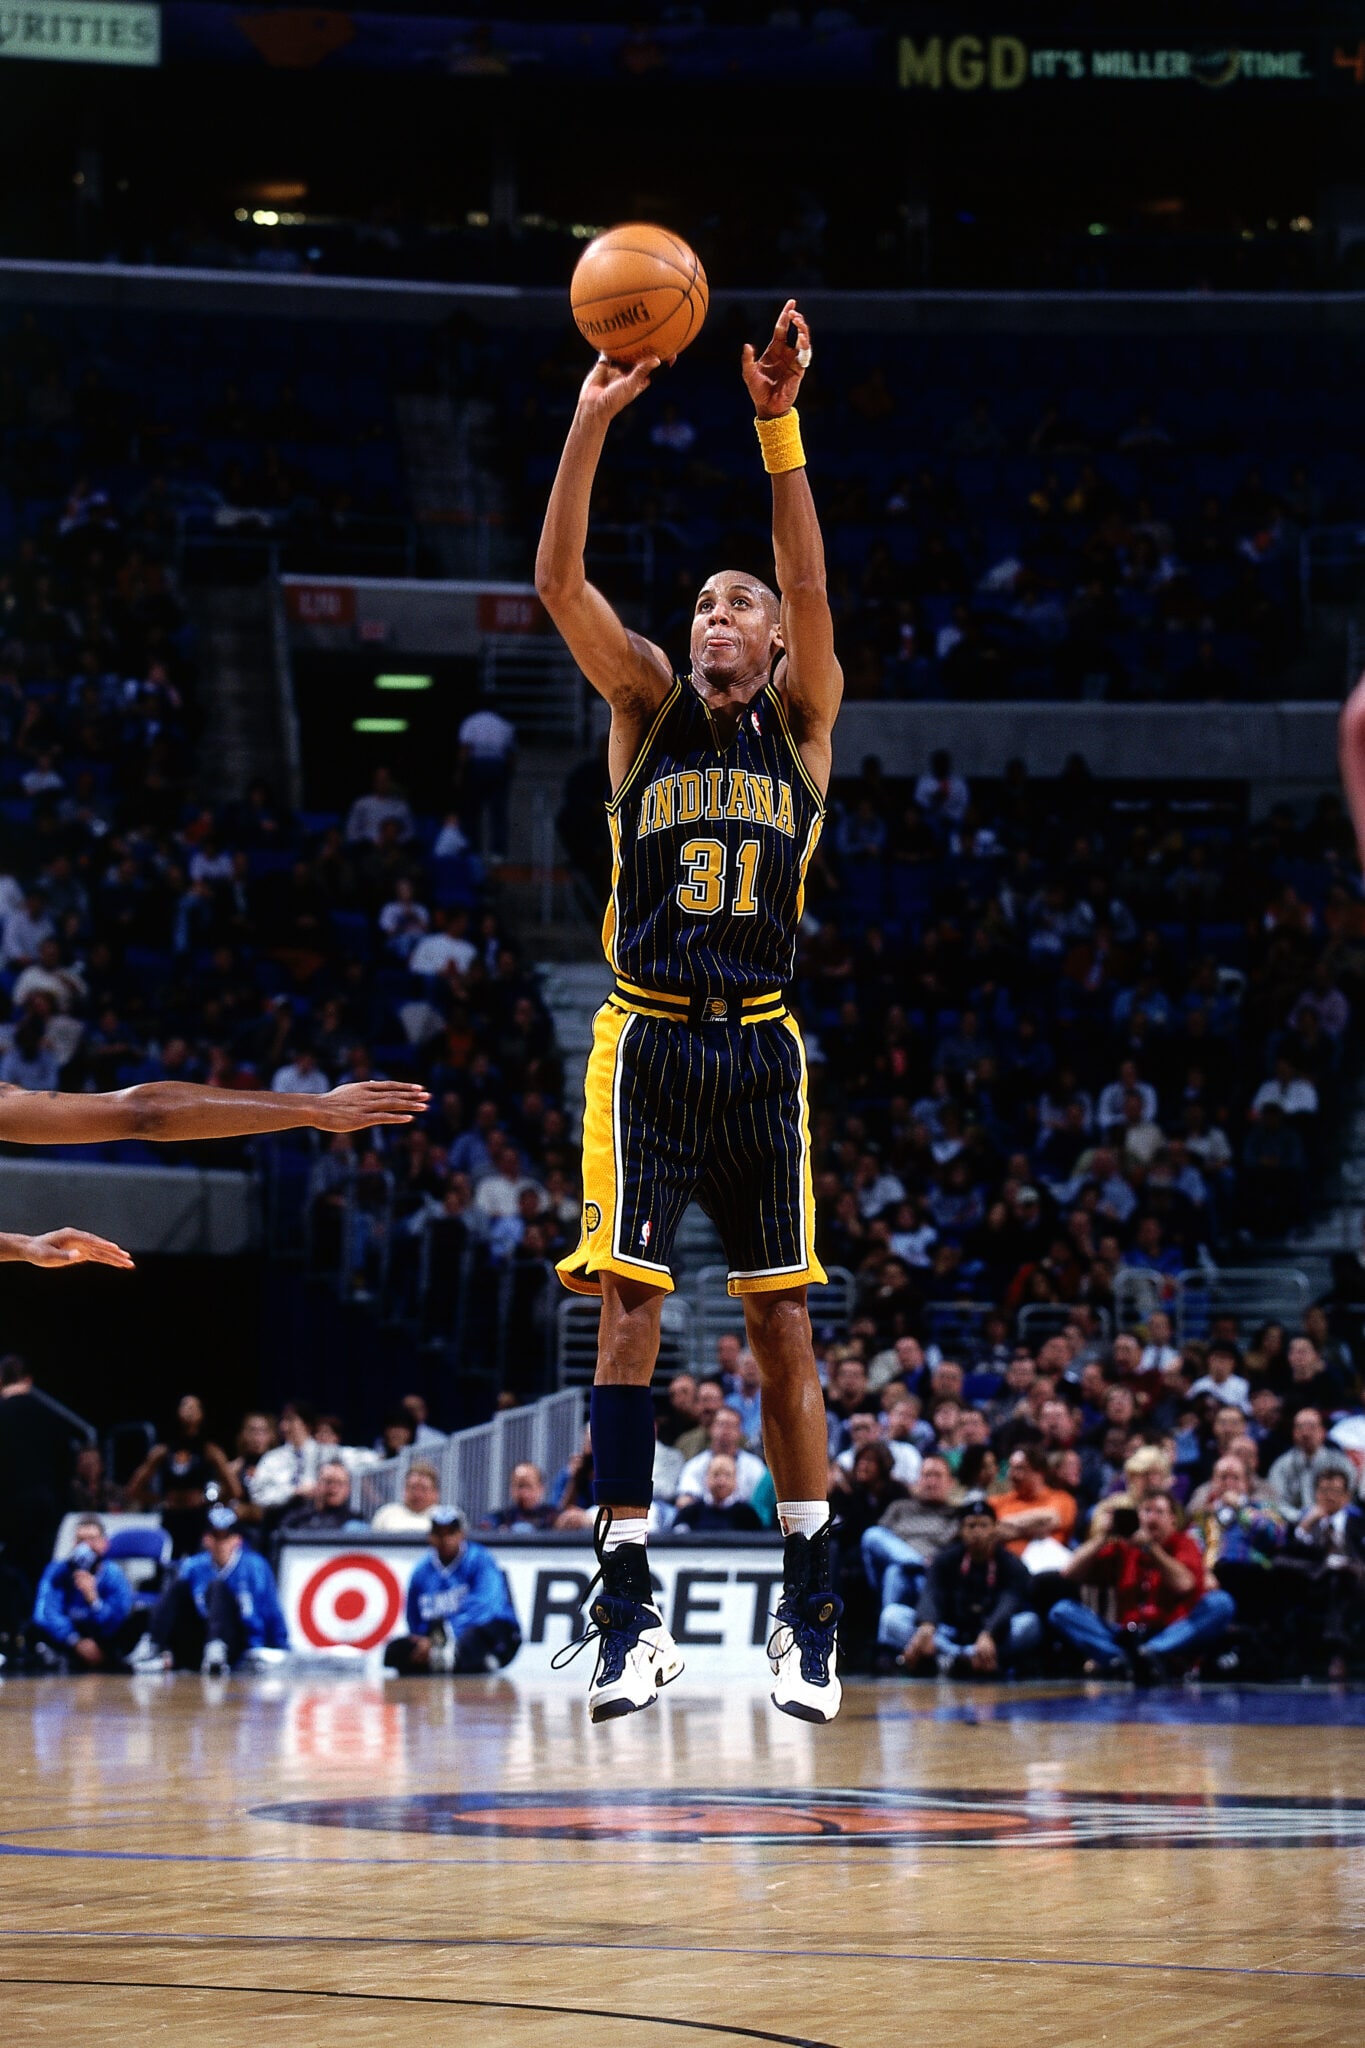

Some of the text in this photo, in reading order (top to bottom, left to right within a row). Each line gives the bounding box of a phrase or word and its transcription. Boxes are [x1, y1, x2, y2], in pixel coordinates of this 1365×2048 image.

[899, 36, 1027, 89] MGD
[1032, 50, 1084, 78] IT'S
[1093, 51, 1191, 78] MILLER
[577, 300, 650, 336] PALDING
[637, 768, 796, 839] INDIANA
[676, 838, 760, 916] 31
